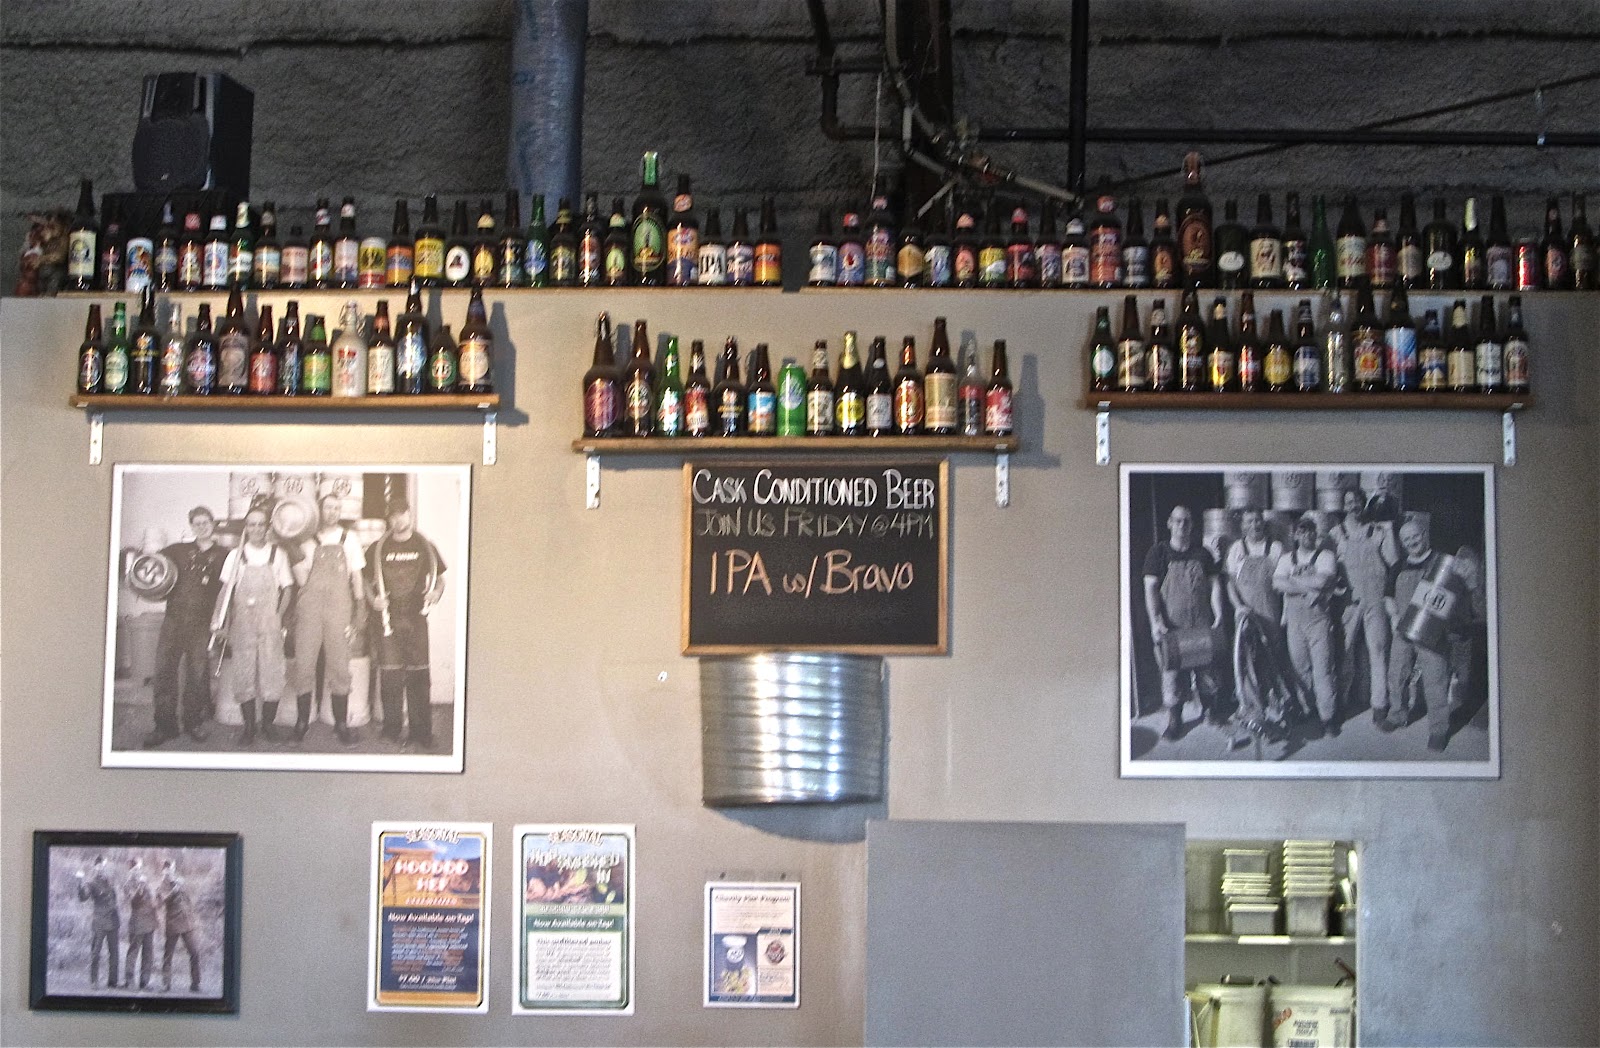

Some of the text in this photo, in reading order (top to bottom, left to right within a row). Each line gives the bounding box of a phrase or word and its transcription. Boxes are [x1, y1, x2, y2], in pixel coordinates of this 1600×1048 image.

[693, 468, 935, 510] CASK CONDITIONED BEER
[696, 506, 742, 536] JOIN
[748, 507, 776, 537] US
[784, 506, 868, 537] FRIDAY
[710, 549, 773, 596] IPA
[388, 912, 407, 922] Now
[407, 912, 444, 922] Available
[552, 918, 586, 928] Available
